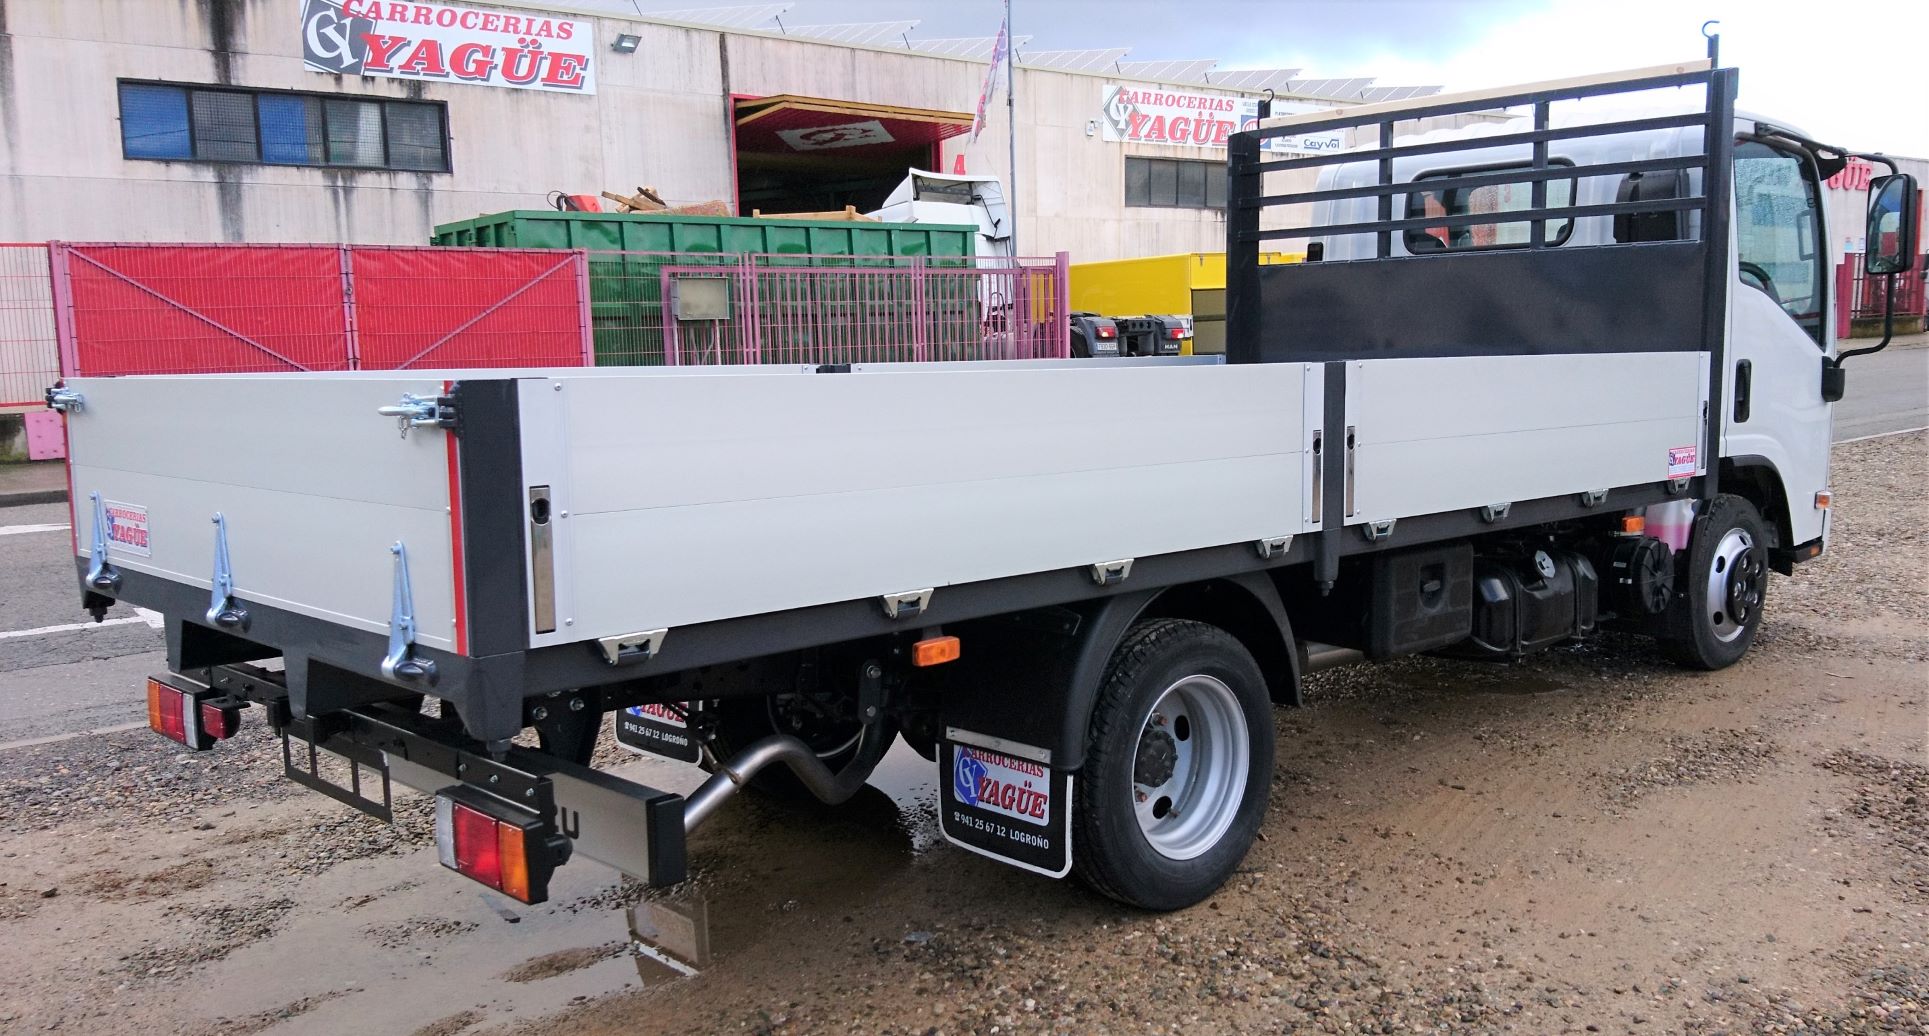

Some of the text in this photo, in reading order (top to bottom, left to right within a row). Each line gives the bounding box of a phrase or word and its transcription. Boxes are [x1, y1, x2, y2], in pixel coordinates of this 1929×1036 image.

[342, 0, 575, 41] CARROCERIAS
[361, 32, 590, 90] YAGÜE
[1118, 88, 1235, 112] CARROCERIAS
[1128, 111, 1236, 147] YAGÜE
[112, 523, 148, 548] YAGÜE
[638, 726, 645, 735] 25
[645, 728, 652, 737] 67
[652, 730, 660, 739] 12
[661, 732, 688, 747] LOGROÑO
[977, 777, 1049, 820] YAGÜE
[960, 814, 1049, 850] 941 25 67 12 LOGROÑO
